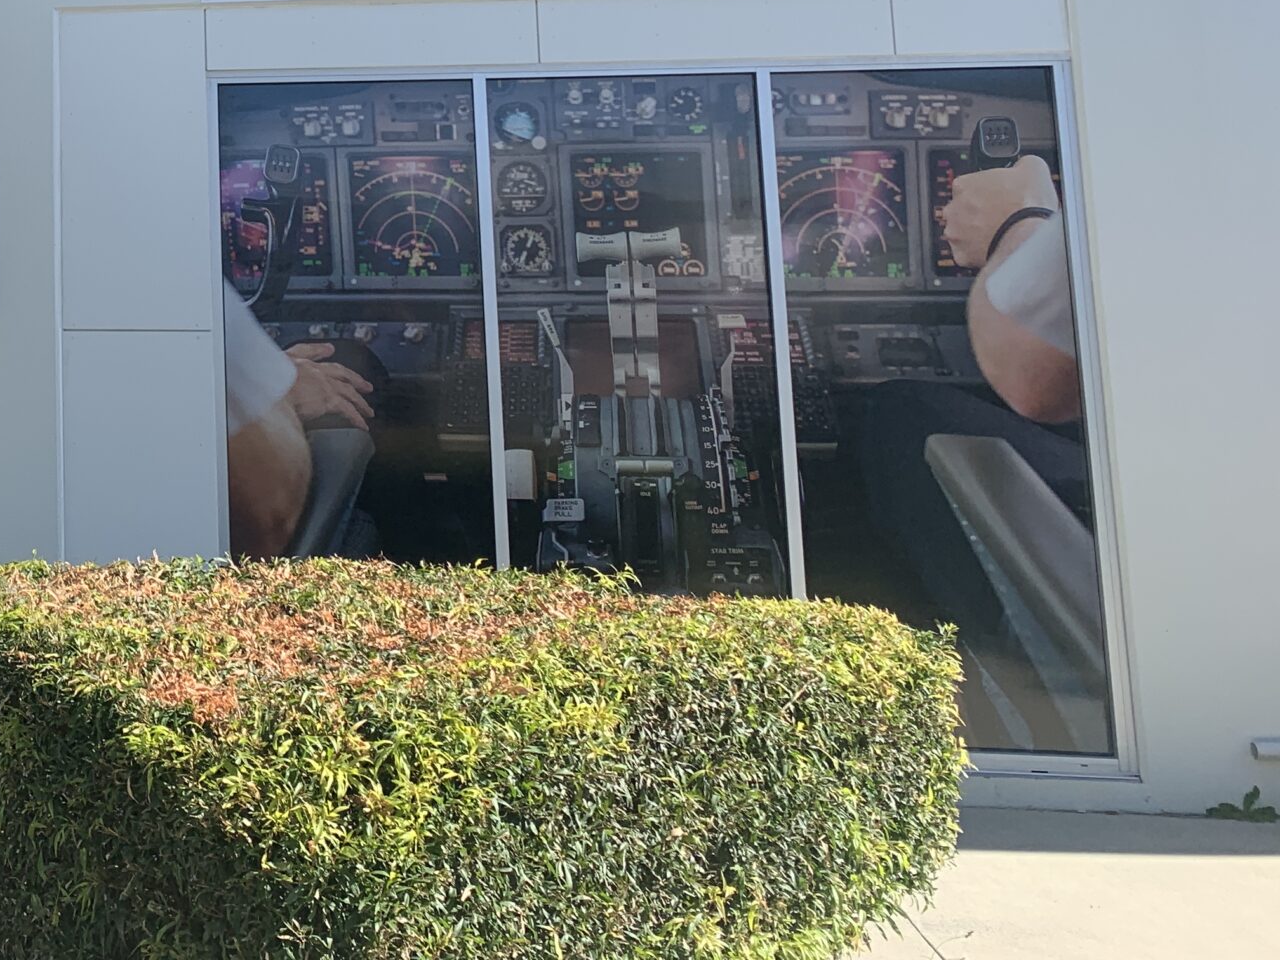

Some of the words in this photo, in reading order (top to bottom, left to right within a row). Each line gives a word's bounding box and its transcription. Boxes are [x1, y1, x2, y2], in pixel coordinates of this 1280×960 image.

[705, 460, 716, 469] 25
[705, 480, 718, 489] 30
[707, 506, 720, 515] 40
